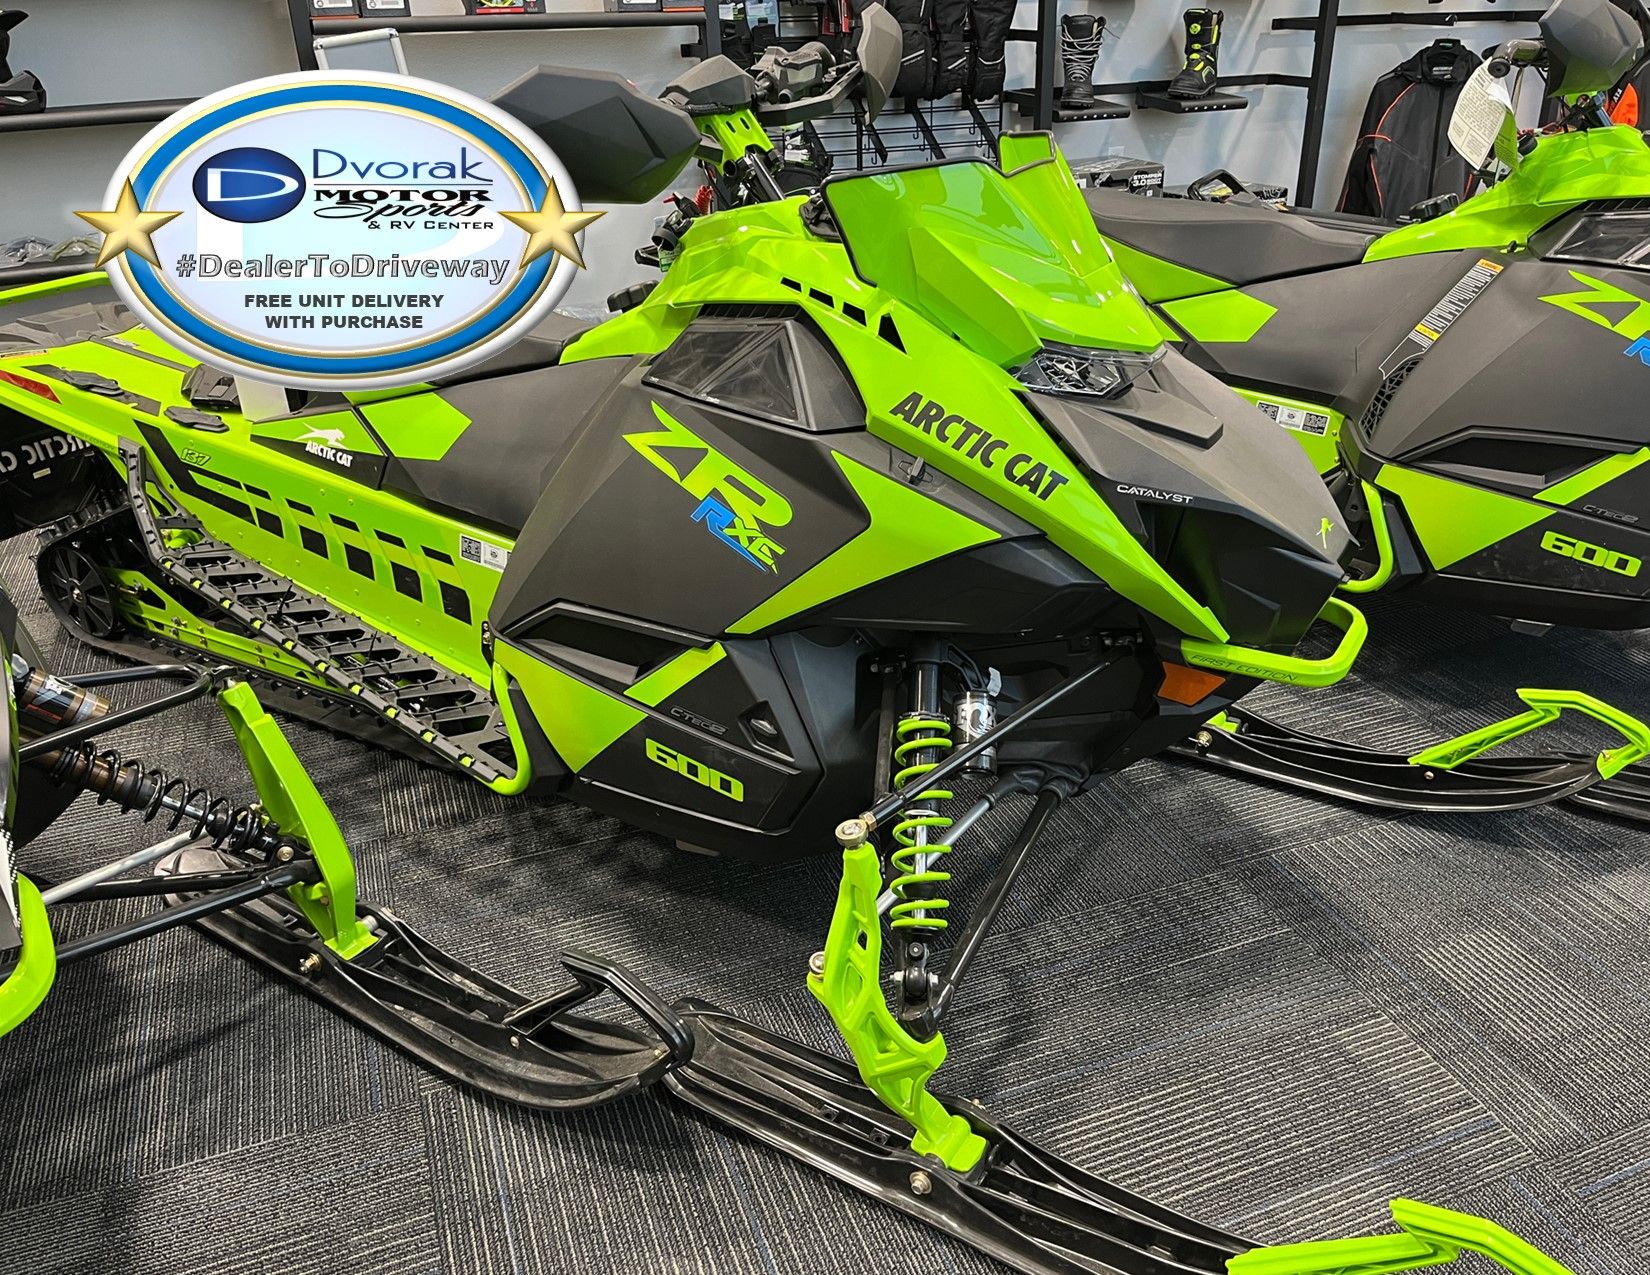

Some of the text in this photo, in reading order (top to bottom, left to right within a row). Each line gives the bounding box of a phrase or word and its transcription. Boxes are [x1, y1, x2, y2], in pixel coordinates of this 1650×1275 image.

[181, 448, 211, 466] 137
[305, 441, 353, 467] ARCTIC CAT
[889, 391, 1069, 501] ARCTIC CAT
[1116, 484, 1193, 504] CATALYST
[1540, 531, 1642, 577] 600
[1191, 654, 1298, 681] FIRST EDITION
[645, 738, 744, 802] 600
